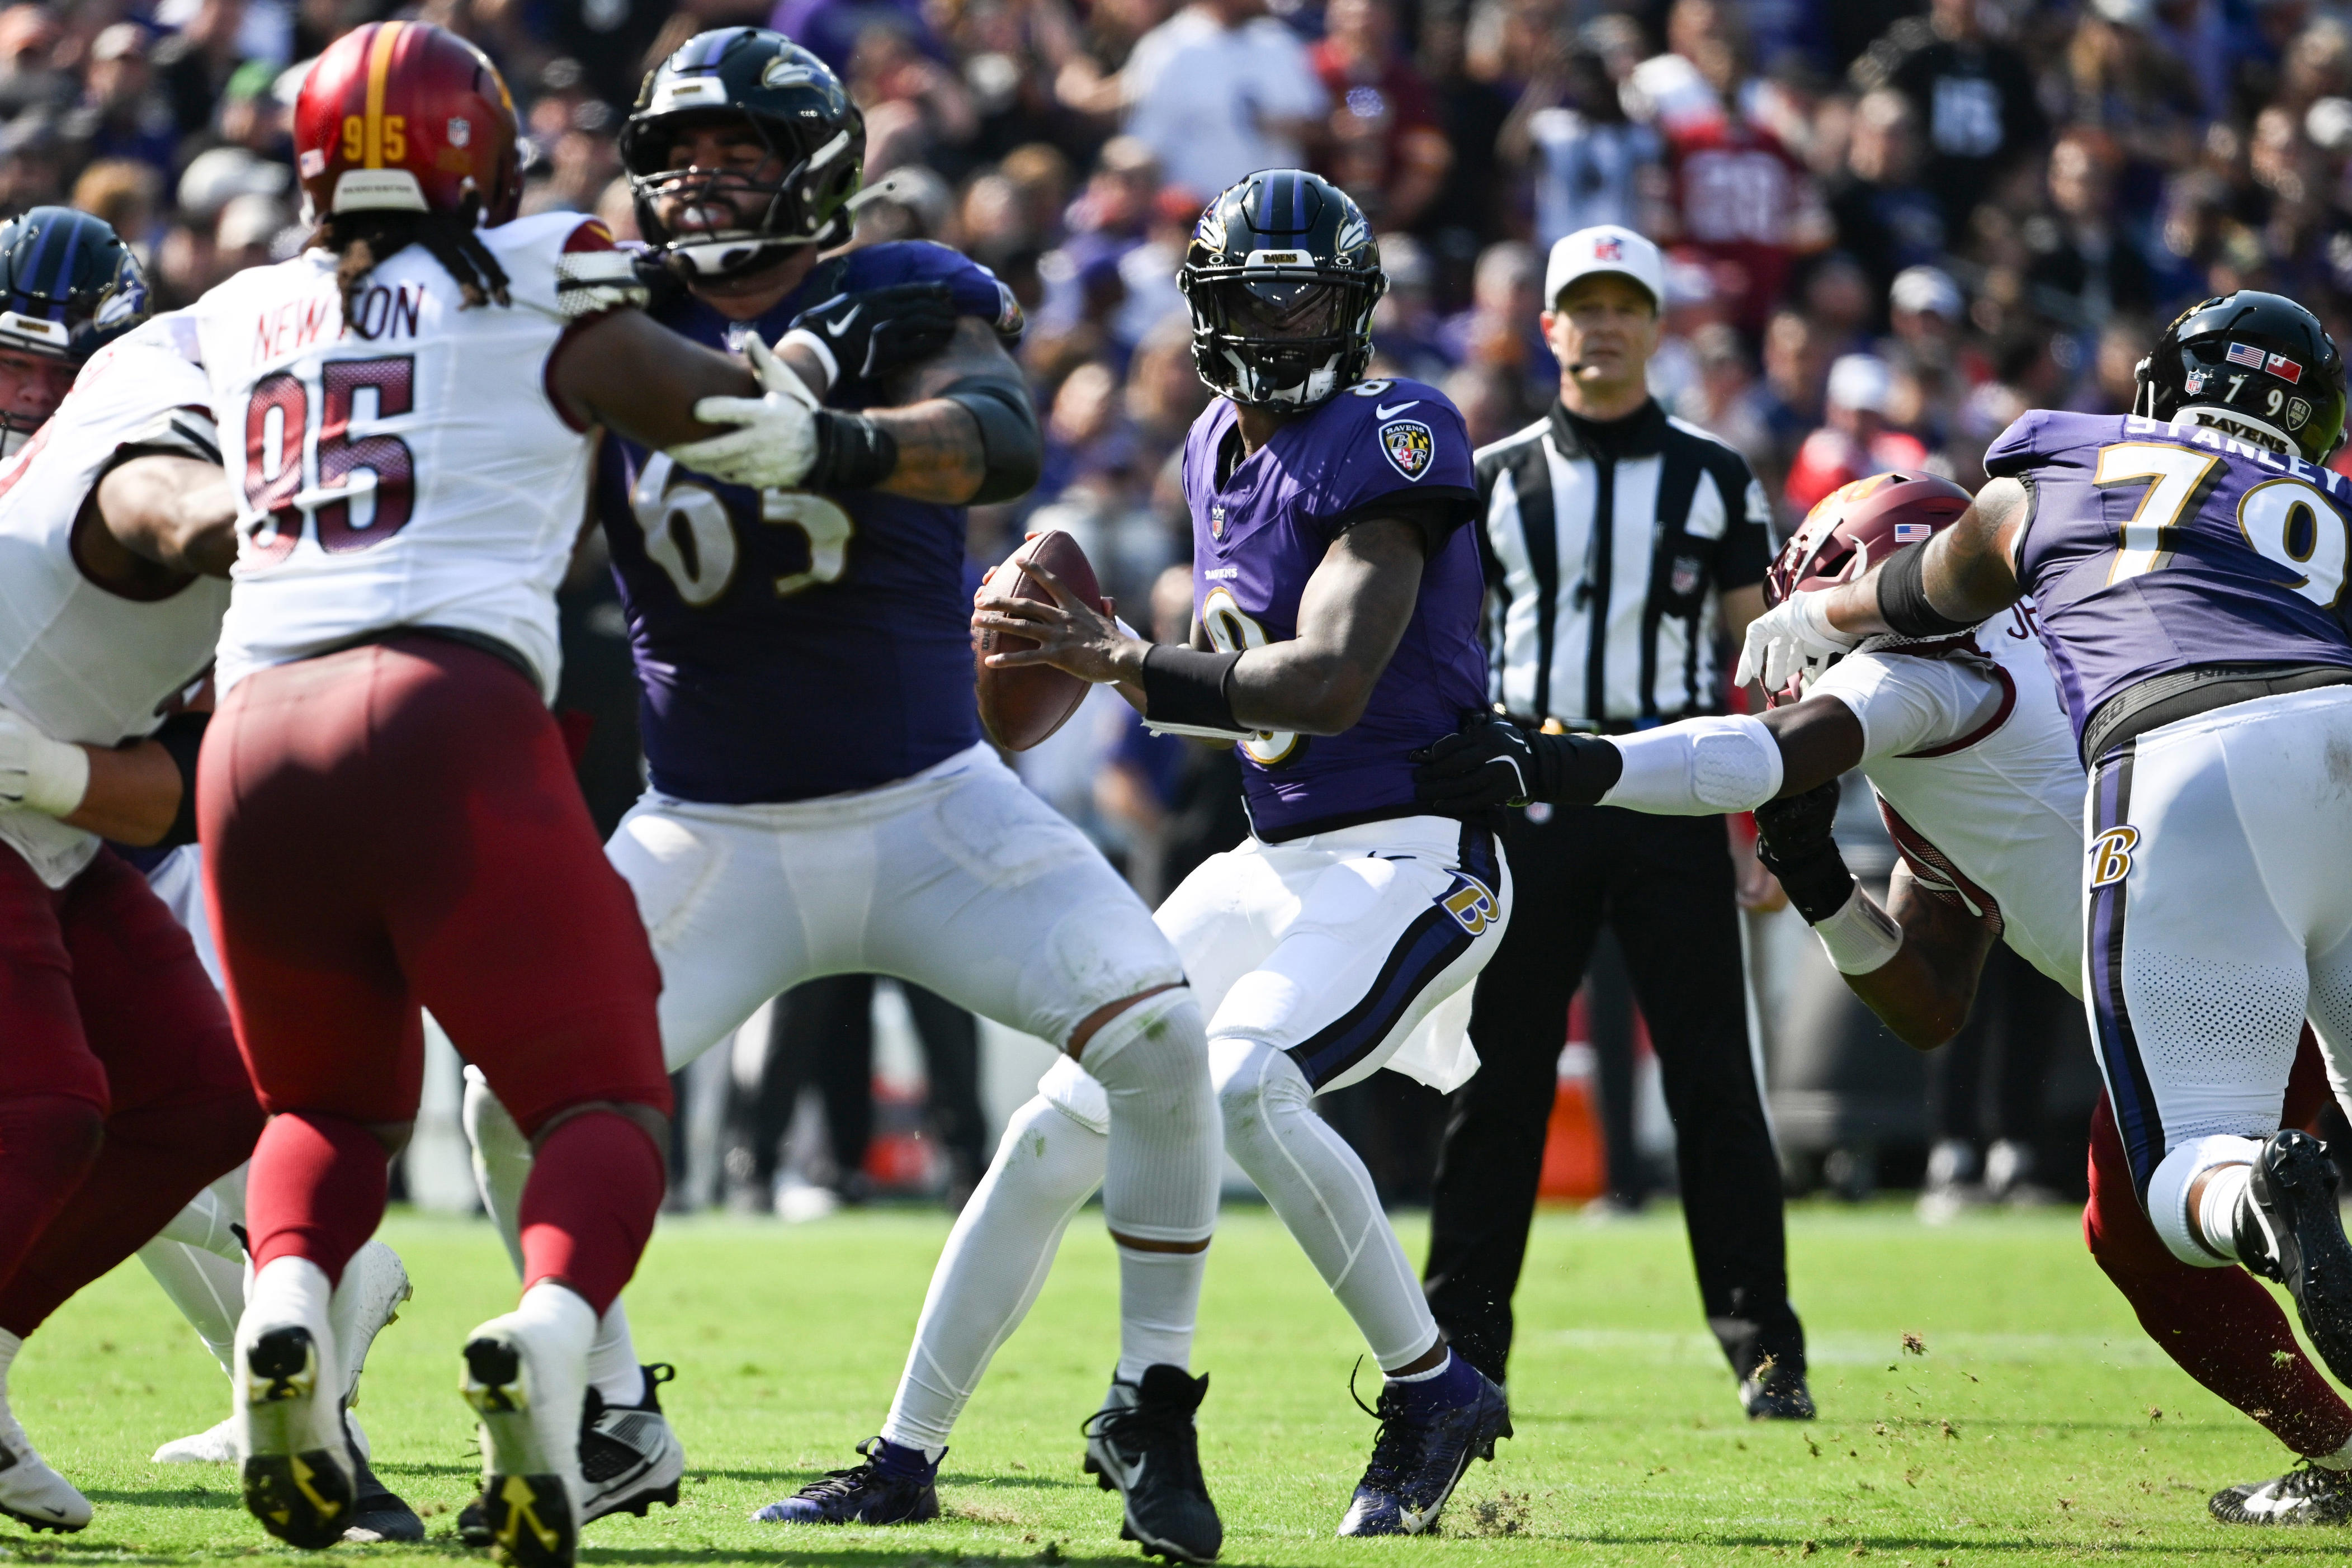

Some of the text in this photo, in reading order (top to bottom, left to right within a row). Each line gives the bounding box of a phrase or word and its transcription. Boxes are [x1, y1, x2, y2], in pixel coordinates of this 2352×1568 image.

[1263, 254, 1297, 263] RAVENS
[2188, 380, 2201, 391] NFL
[1385, 424, 1425, 434] RAVENS
[2195, 412, 2289, 455] RAVENS
[244, 353, 417, 574] 95
[2093, 442, 2350, 610] 79
[1205, 568, 1238, 580] RAVENS
[2087, 824, 2141, 894] B
[1432, 868, 1501, 937] B
